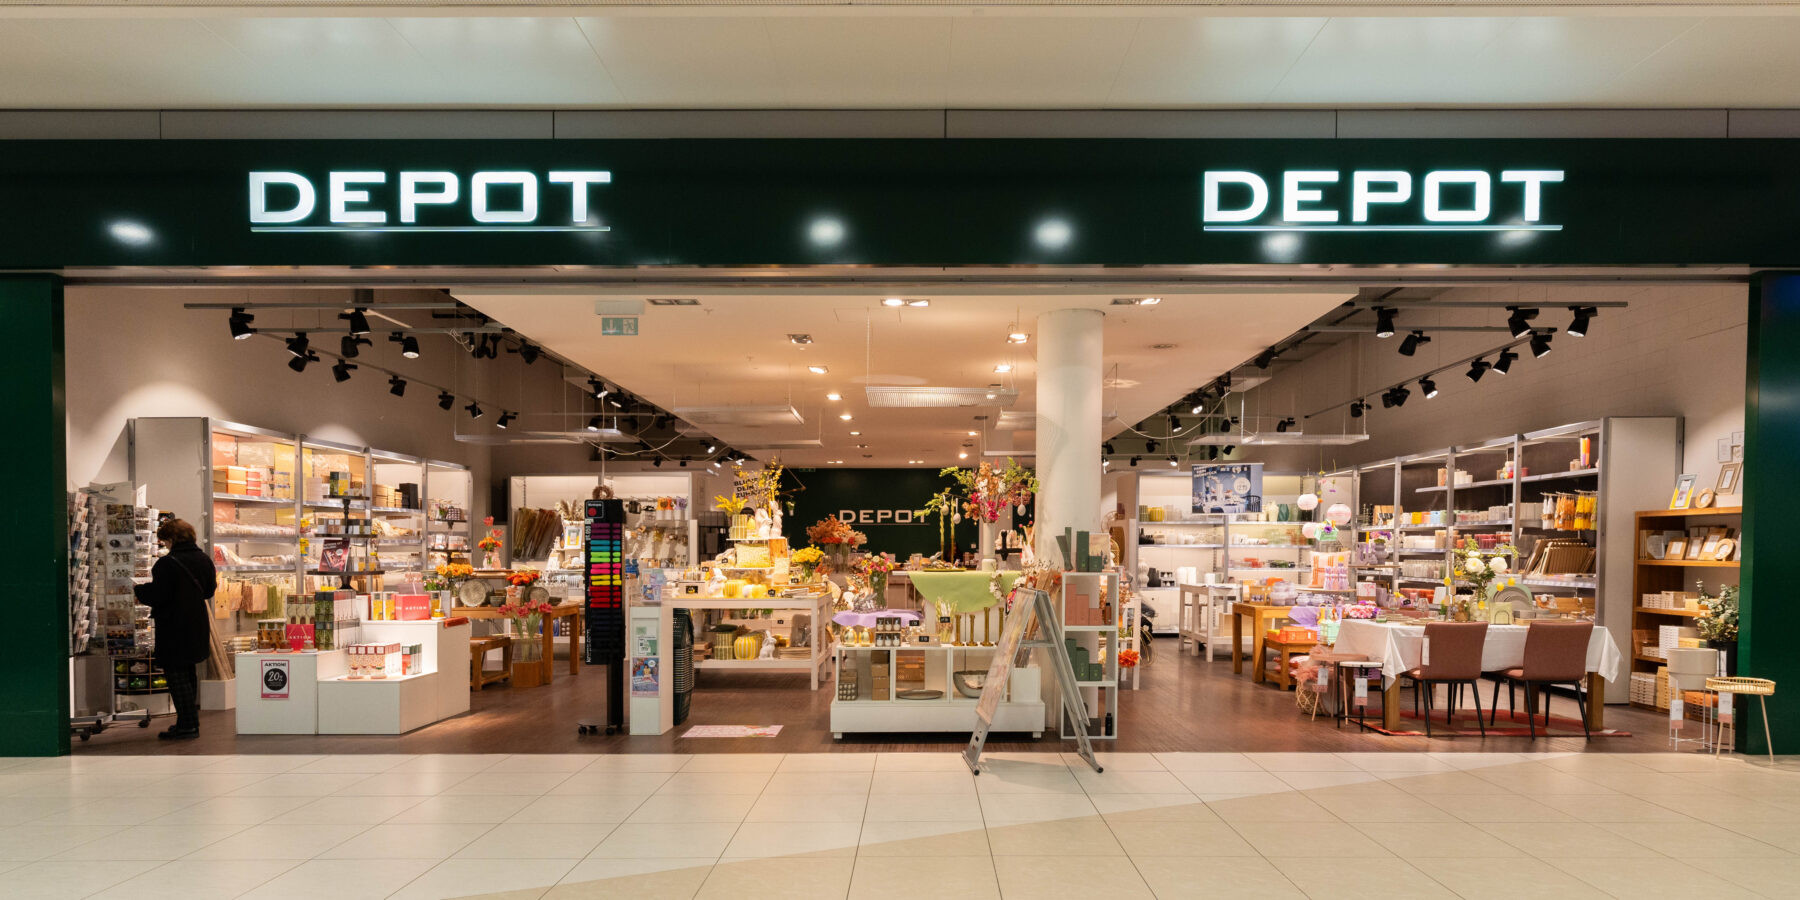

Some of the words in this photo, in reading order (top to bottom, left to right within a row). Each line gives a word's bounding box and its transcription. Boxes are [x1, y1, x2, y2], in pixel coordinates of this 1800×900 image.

[249, 171, 611, 223] DEPOT
[1204, 170, 1565, 222] DEPOT
[839, 510, 928, 524] DEPOT
